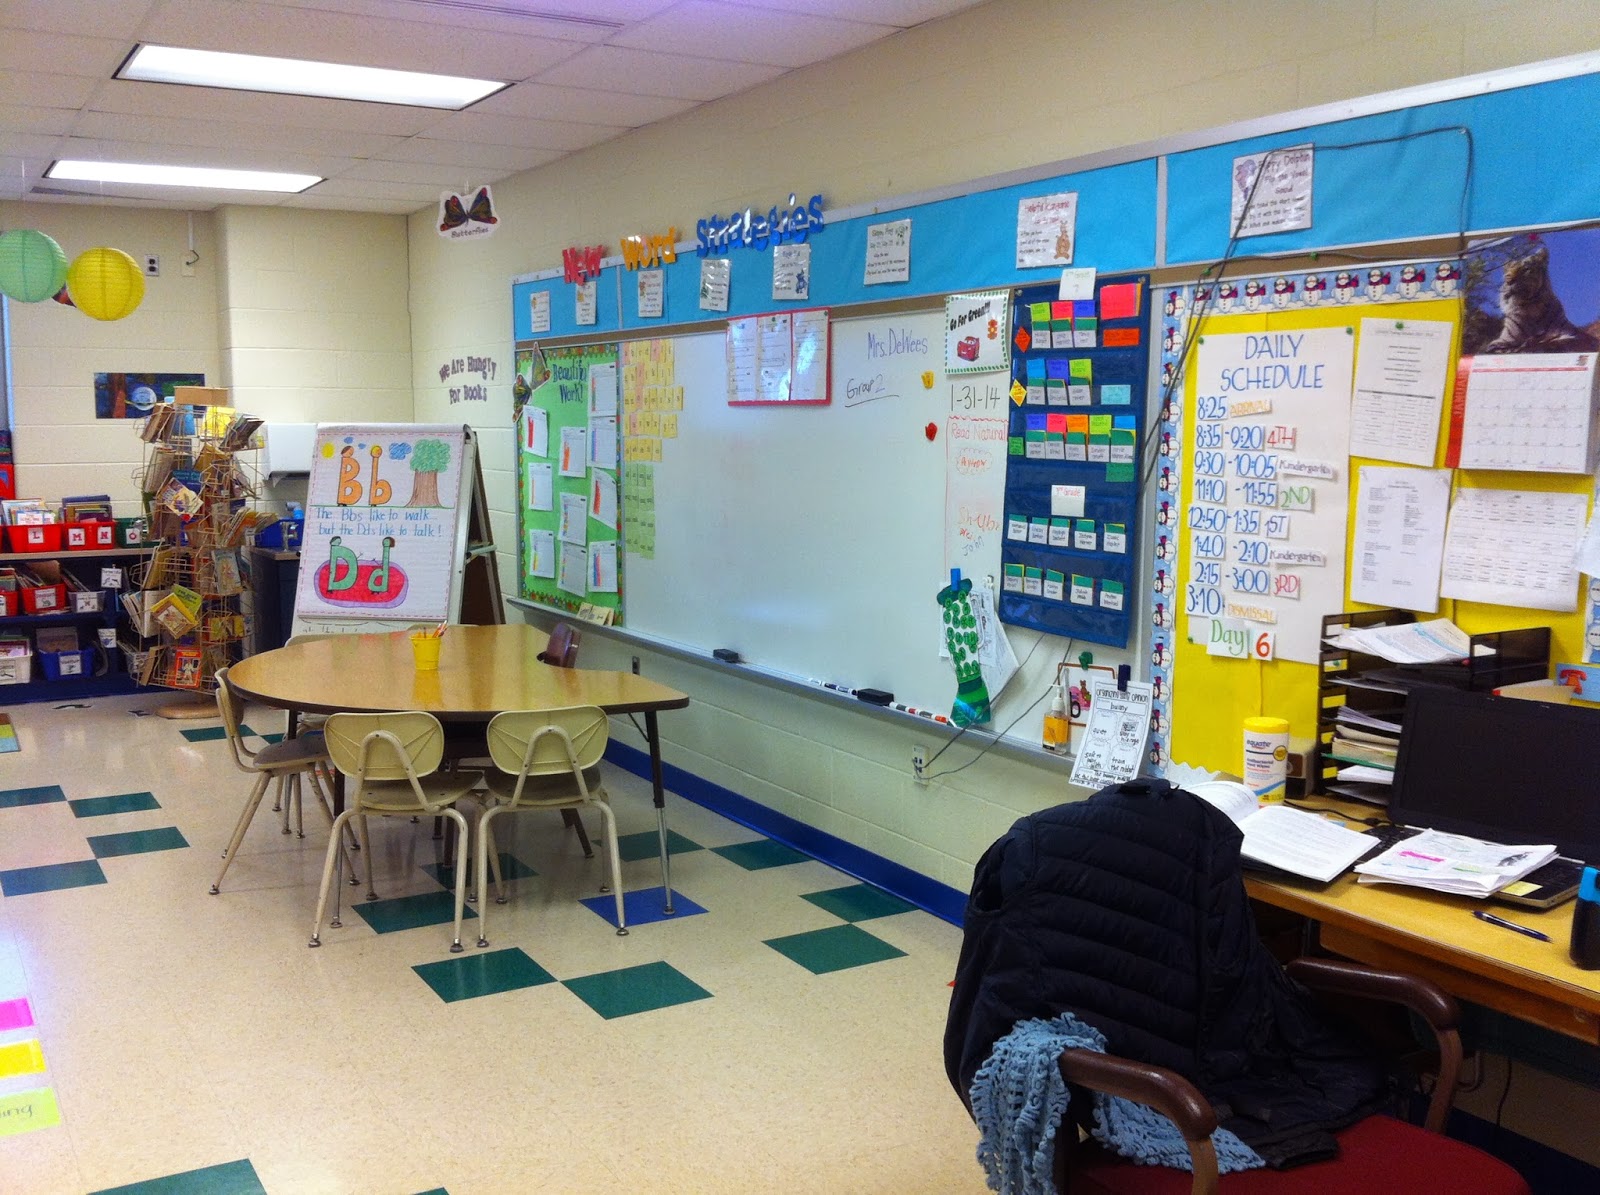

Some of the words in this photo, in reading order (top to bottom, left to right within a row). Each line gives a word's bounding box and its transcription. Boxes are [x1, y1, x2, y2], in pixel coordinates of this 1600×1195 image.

[1245, 334, 1304, 360] DAILY
[451, 359, 465, 375] Are
[467, 356, 496, 380] Hungry
[1220, 364, 1325, 392] SCHEDULE
[463, 384, 487, 402] Books
[951, 384, 1001, 412] 1-31-14
[1198, 395, 1227, 420] 8:25
[1196, 423, 1221, 448] 8:35
[1231, 425, 1263, 450] 9:20
[1267, 425, 1297, 448] 4TH
[1195, 450, 1224, 473] 9:30
[1234, 453, 1277, 478] 10:05
[1195, 478, 1225, 502] 11:10
[1243, 481, 1277, 506] 11:55
[1280, 486, 1311, 508] 2ND
[317, 507, 333, 519] The
[369, 508, 386, 522] like
[388, 508, 399, 520] to
[1190, 506, 1226, 532] 12:50
[1233, 509, 1259, 533] 1:35
[32, 531, 40, 540] L
[72, 532, 83, 541] M
[100, 531, 108, 540] N
[319, 522, 336, 535] but
[340, 522, 353, 536] the
[1238, 540, 1269, 566] 2:10
[1195, 561, 1220, 585] 2:15
[1232, 567, 1269, 593] 3:00
[1273, 574, 1301, 596] 3RD
[1187, 584, 1221, 616] 3:10
[1210, 619, 1245, 657] Day
[1255, 632, 1271, 658] 6
